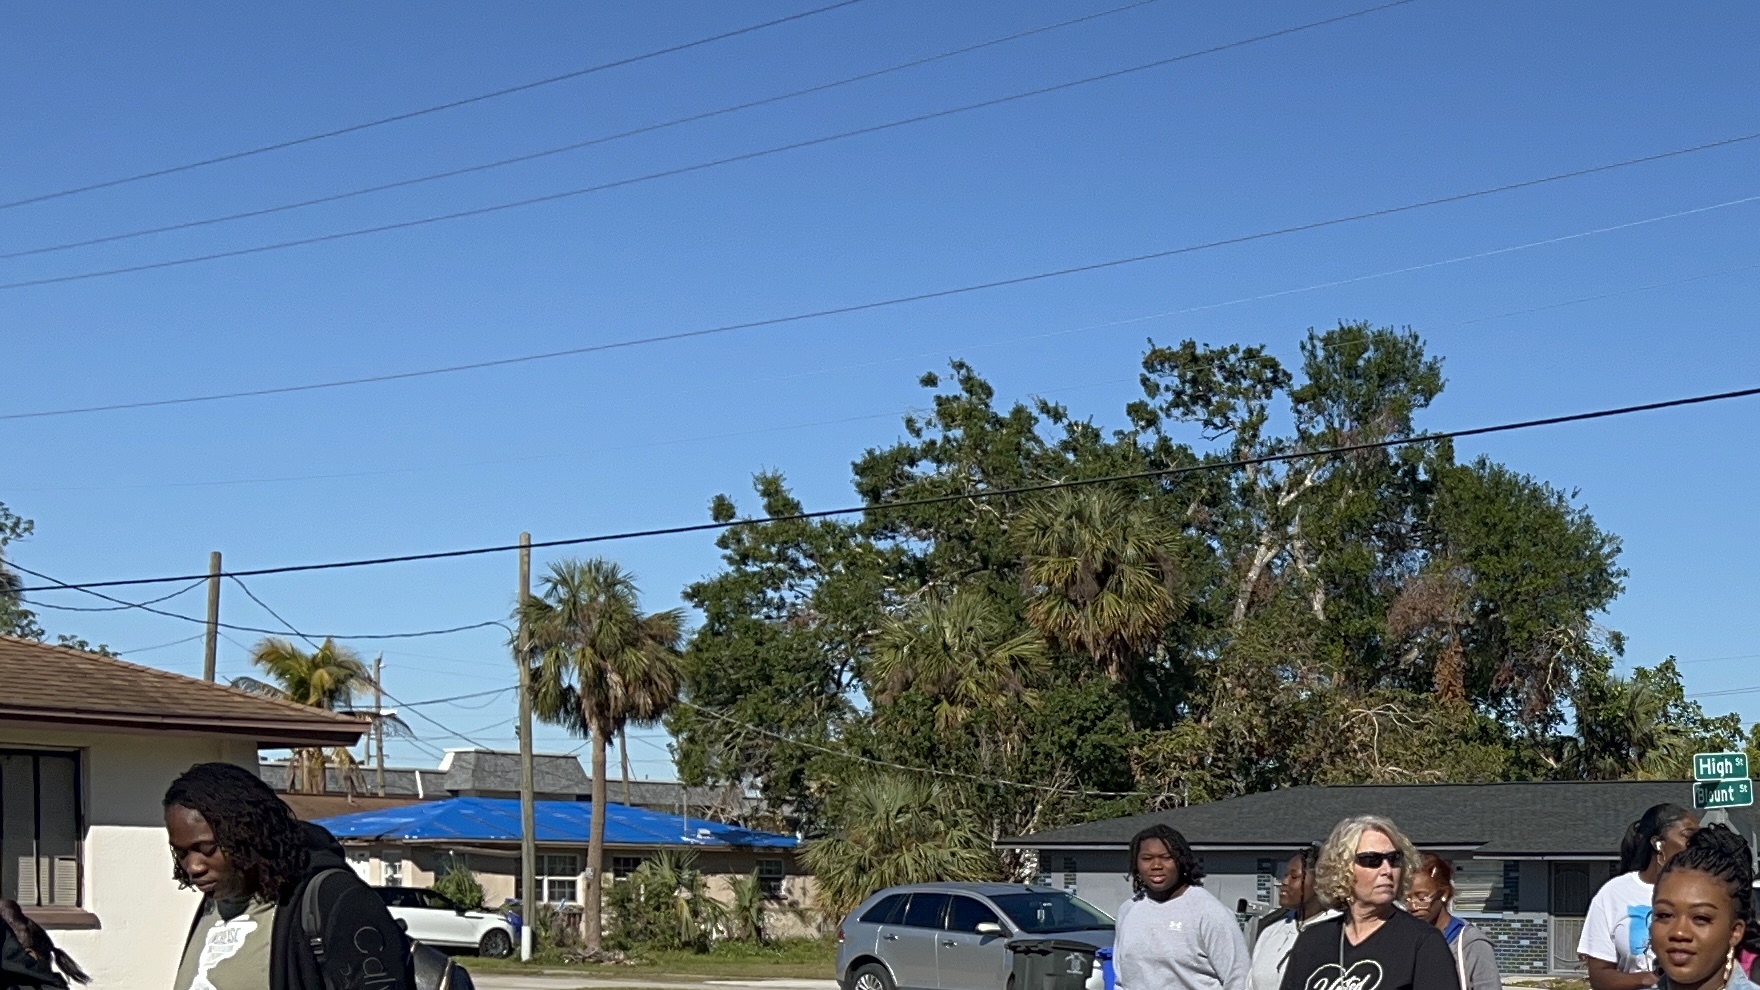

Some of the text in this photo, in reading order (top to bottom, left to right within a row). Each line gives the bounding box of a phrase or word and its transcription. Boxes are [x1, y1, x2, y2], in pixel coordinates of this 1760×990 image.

[1699, 757, 1744, 777] High St
[1696, 783, 1748, 804] Blount St
